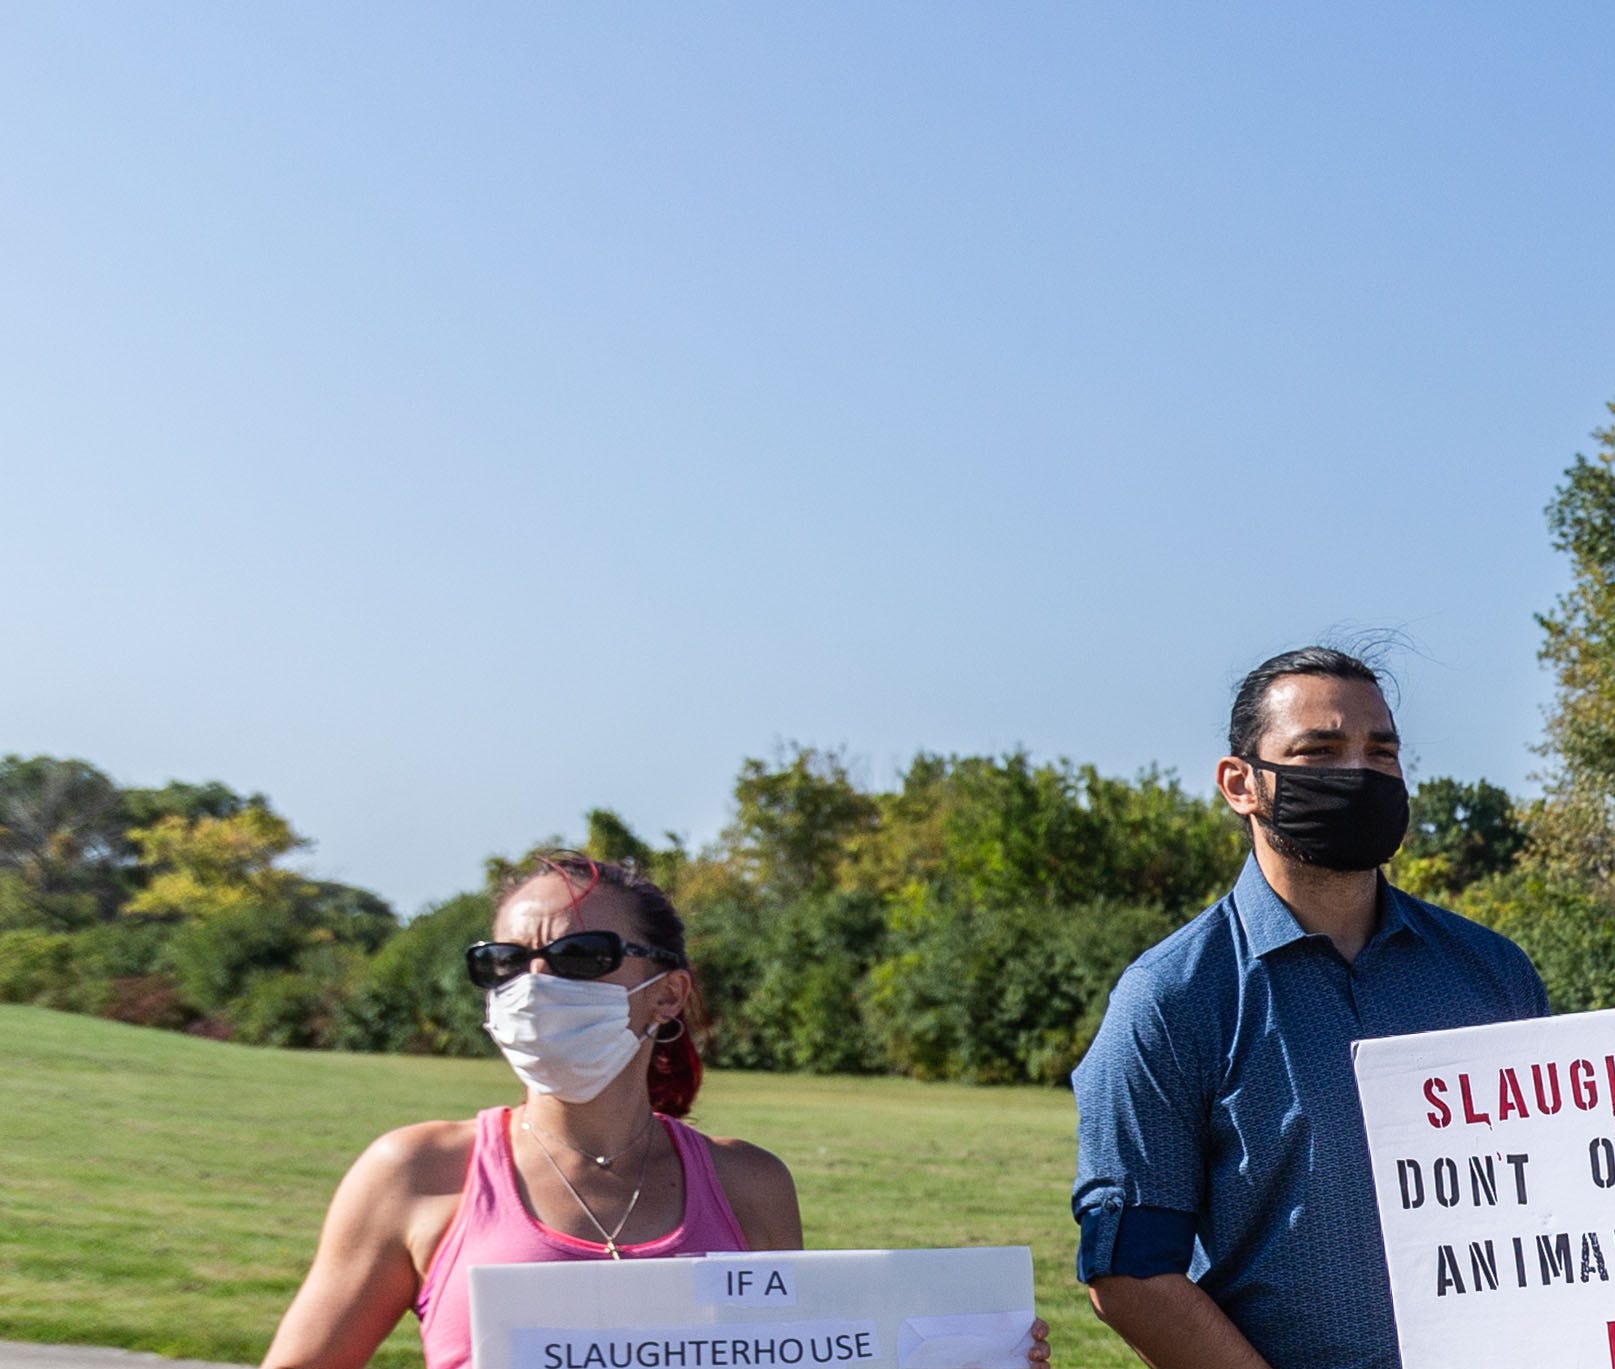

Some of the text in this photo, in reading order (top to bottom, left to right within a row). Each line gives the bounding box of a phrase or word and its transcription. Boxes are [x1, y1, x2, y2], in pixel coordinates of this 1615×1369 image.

[726, 1270, 787, 1297] IF A
[544, 1332, 873, 1369] SLAUGHTERHOUSE
